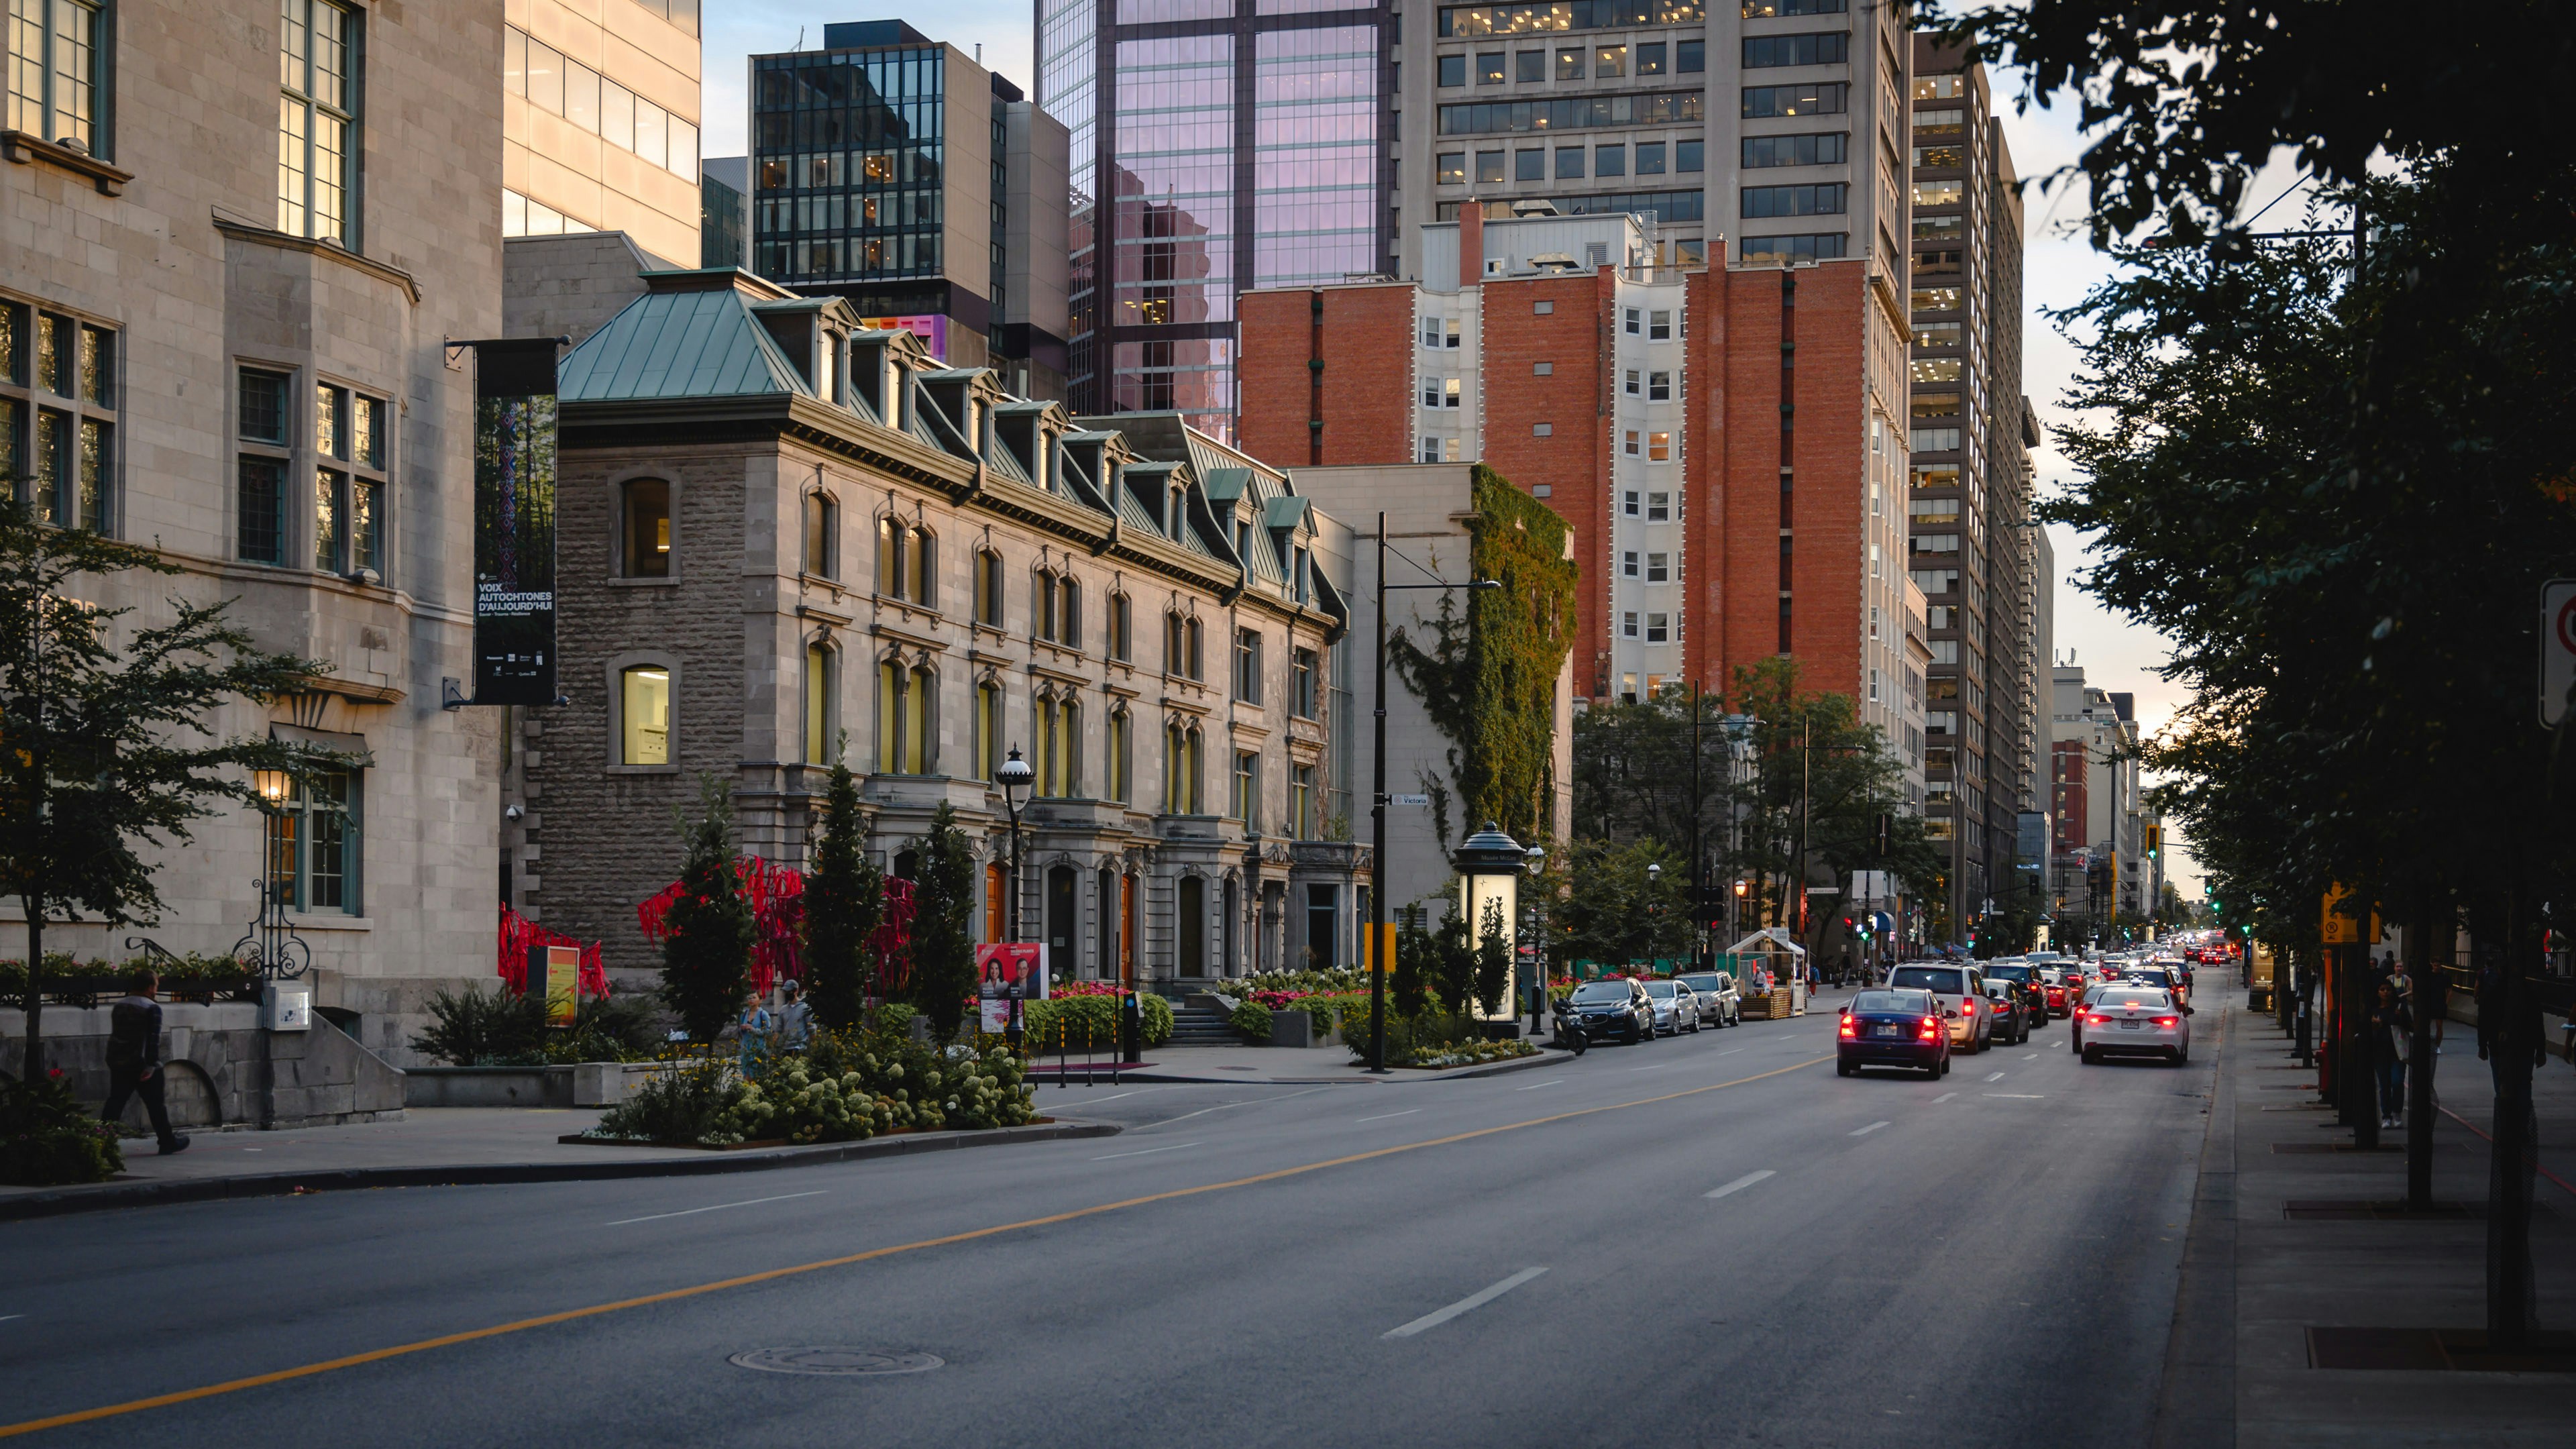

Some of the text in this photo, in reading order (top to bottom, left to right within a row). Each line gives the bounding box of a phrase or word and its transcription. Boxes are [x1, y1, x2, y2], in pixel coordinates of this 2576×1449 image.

[479, 584, 502, 592] VOIX
[479, 592, 552, 602] AUTOCHTONES
[479, 602, 552, 611] D'AUJOURD'HUI
